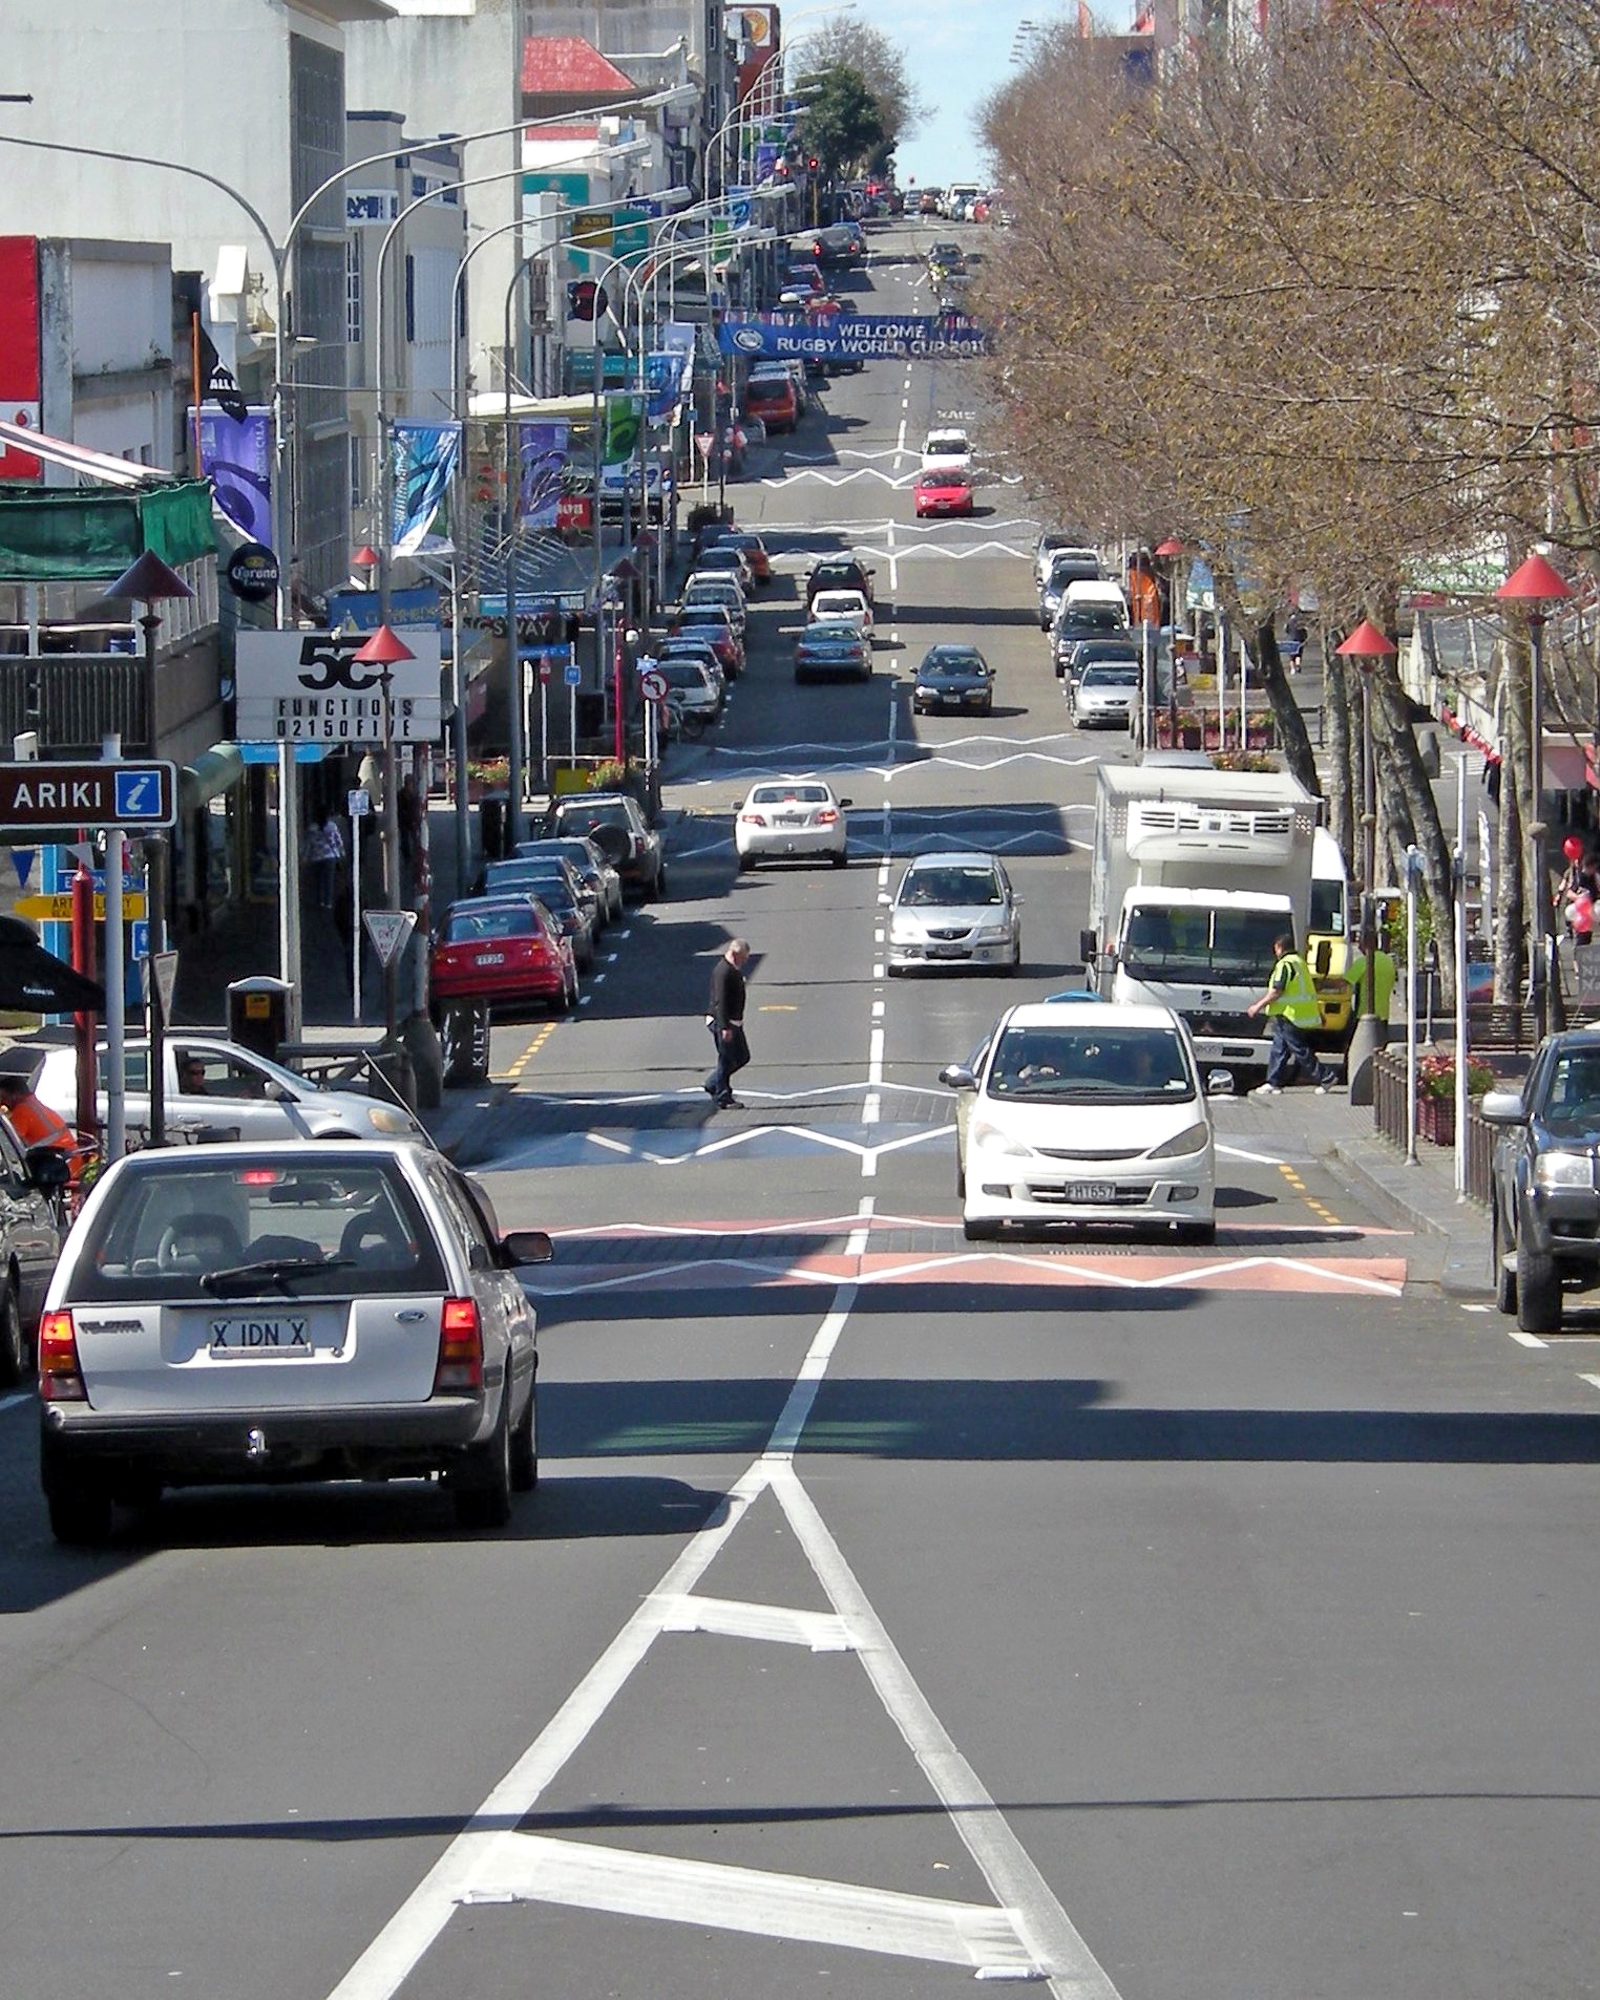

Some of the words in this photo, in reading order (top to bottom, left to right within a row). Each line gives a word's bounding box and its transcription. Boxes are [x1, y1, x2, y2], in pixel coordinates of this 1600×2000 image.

[839, 324, 925, 339] WELCOME
[777, 337, 837, 353] RUGBY
[841, 338, 906, 354] WORLD
[910, 340, 944, 354] CUP
[209, 378, 231, 390] ALL
[231, 566, 277, 580] Corona
[13, 782, 101, 809] ARIKI
[1067, 1184, 1113, 1199] FHT657
[213, 1324, 227, 1347] X
[291, 1322, 305, 1345] X
